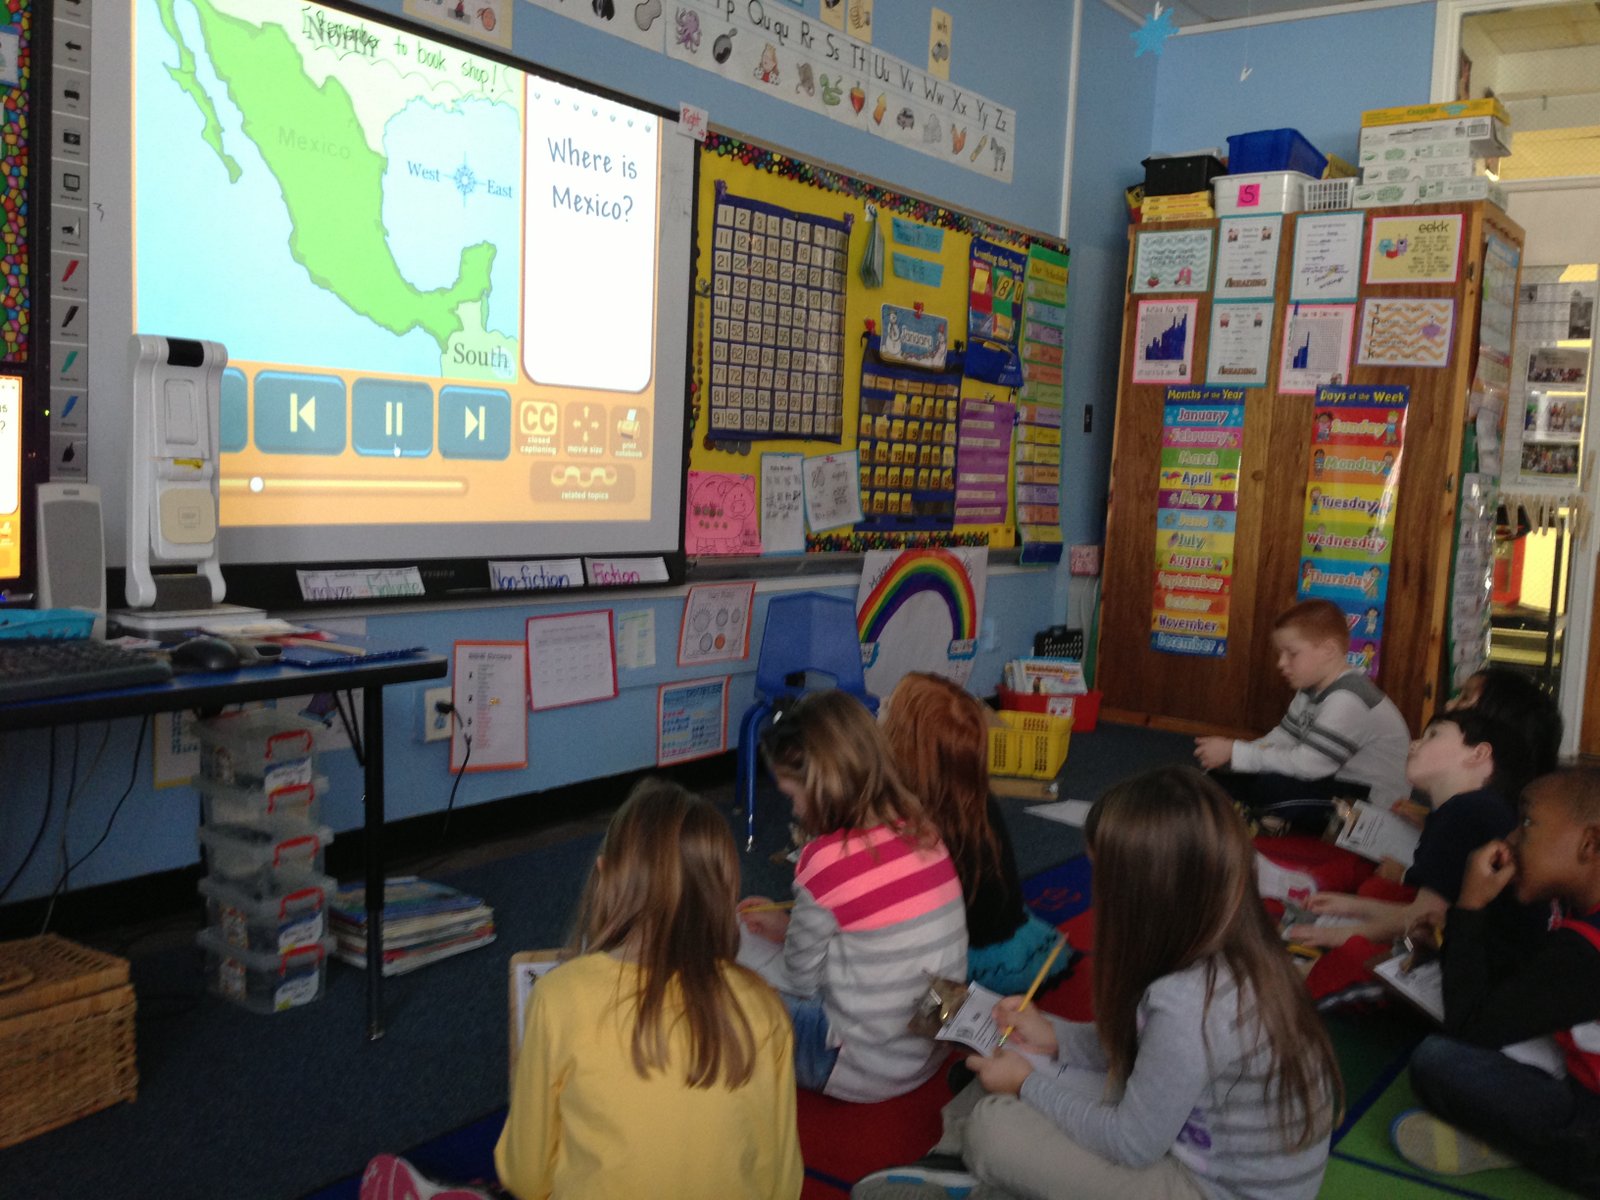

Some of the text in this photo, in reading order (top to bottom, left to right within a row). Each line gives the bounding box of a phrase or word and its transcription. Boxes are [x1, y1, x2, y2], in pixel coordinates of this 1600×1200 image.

[394, 36, 408, 55] to
[417, 40, 447, 72] book
[461, 59, 497, 92] shop!
[801, 20, 815, 48] Rr
[826, 33, 840, 60] Ss
[851, 43, 865, 71] Tt
[874, 54, 890, 82] Uu
[900, 65, 914, 92] Vv
[924, 76, 944, 105] Ww
[952, 89, 967, 116] Xx
[976, 98, 988, 130] Yy
[995, 108, 1007, 132] Zz
[278, 125, 352, 160] Mexico
[548, 137, 638, 180] Where is
[407, 160, 440, 182] West
[486, 178, 513, 199] East
[552, 185, 634, 223] Mexico?
[1419, 220, 1450, 234] eekk
[718, 255, 729, 268] 21
[999, 280, 1010, 297] 8
[453, 342, 508, 368] South
[1168, 389, 1201, 400] Months
[1222, 388, 1244, 400] Year
[1320, 390, 1347, 404] Days
[1349, 392, 1357, 400] of
[1374, 392, 1405, 402] Week
[522, 404, 556, 432] CC
[1178, 408, 1229, 425] January
[1172, 428, 1230, 446] February
[1330, 418, 1388, 440] Sunday
[1178, 450, 1218, 466] March
[1324, 456, 1386, 475] Monday
[1182, 470, 1212, 486] April
[562, 490, 609, 501] related topics
[1180, 490, 1210, 508] May
[1320, 496, 1379, 515] Tuesday
[1178, 532, 1206, 550] July
[1306, 532, 1388, 553] Wednesday
[1168, 552, 1213, 569] August
[492, 562, 641, 591] Non-fiction Fiction
[1158, 572, 1224, 592] September
[1308, 568, 1376, 592] Thursday
[1158, 614, 1218, 632] November
[1157, 632, 1217, 652] December
